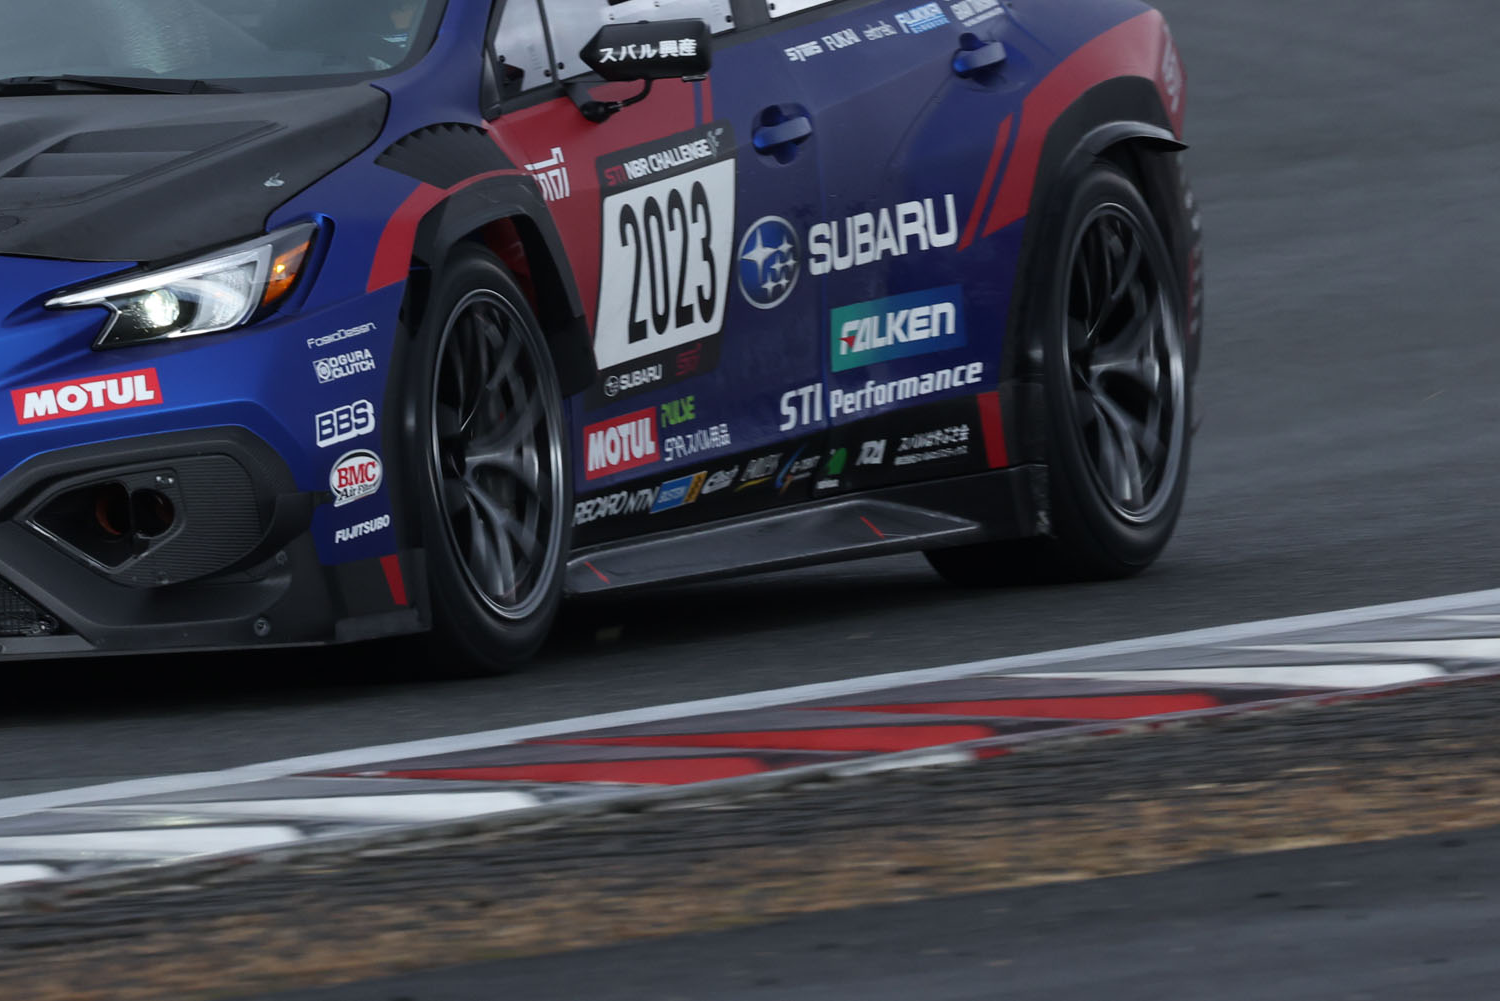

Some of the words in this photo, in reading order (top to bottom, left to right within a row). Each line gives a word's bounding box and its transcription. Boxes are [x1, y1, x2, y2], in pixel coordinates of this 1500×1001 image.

[599, 38, 697, 64] スバル興産
[623, 157, 651, 180] NBR
[650, 138, 713, 174] CHALLENGE
[808, 194, 958, 276] SUBARU
[619, 181, 717, 345] 2023
[839, 301, 956, 355] FALKEN
[329, 348, 373, 368] OGURA
[332, 359, 376, 379] CLUTCH
[619, 363, 663, 391] SUBARU
[20, 373, 159, 420] MOTUL
[779, 383, 823, 431] STI
[830, 361, 984, 418] Performance
[316, 399, 375, 448] BBS
[587, 417, 657, 472] MOTUL
[337, 461, 376, 488] BMC
[334, 514, 390, 544] FUJITSUBO
[572, 490, 628, 526] RECARO
